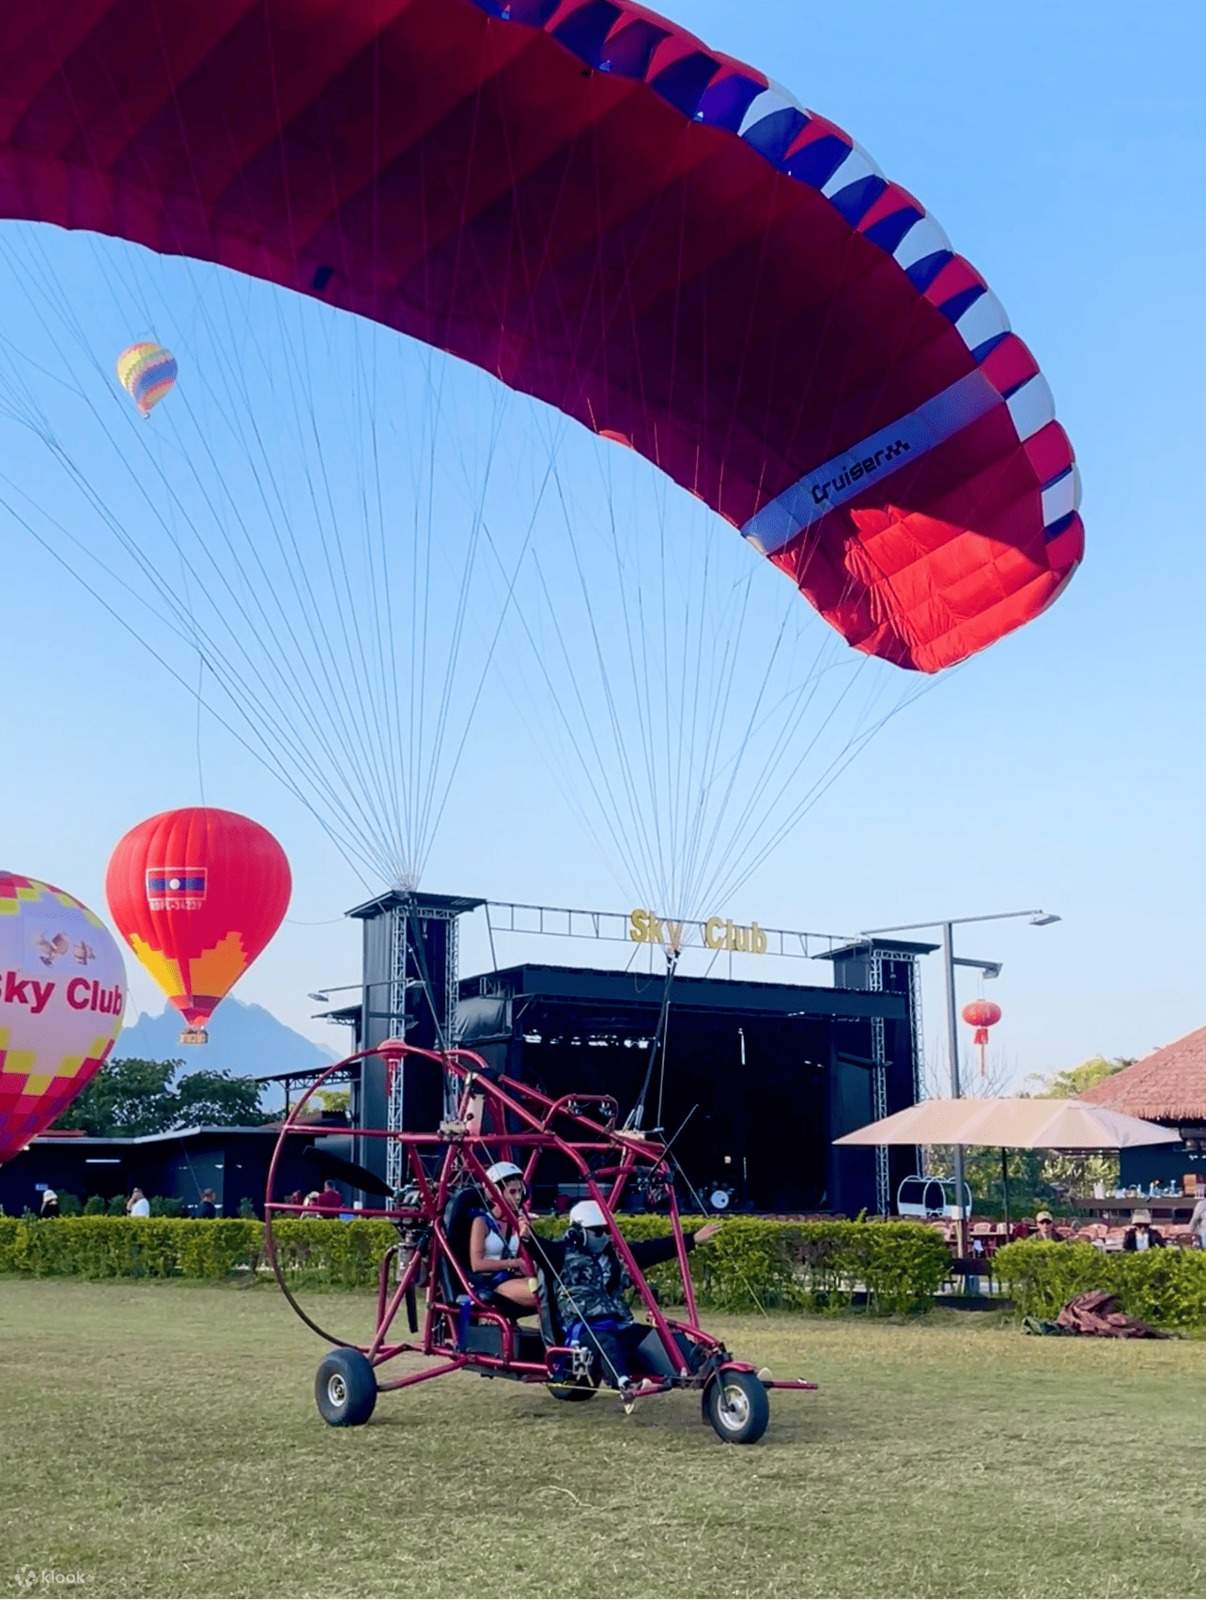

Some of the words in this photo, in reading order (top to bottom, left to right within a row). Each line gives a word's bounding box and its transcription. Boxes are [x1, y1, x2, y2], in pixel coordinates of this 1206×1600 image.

[811, 449, 884, 504] Cruiser
[630, 908, 683, 951] Sky
[705, 916, 767, 954] Club
[0, 971, 55, 1014] ky
[67, 977, 122, 1016] Club
